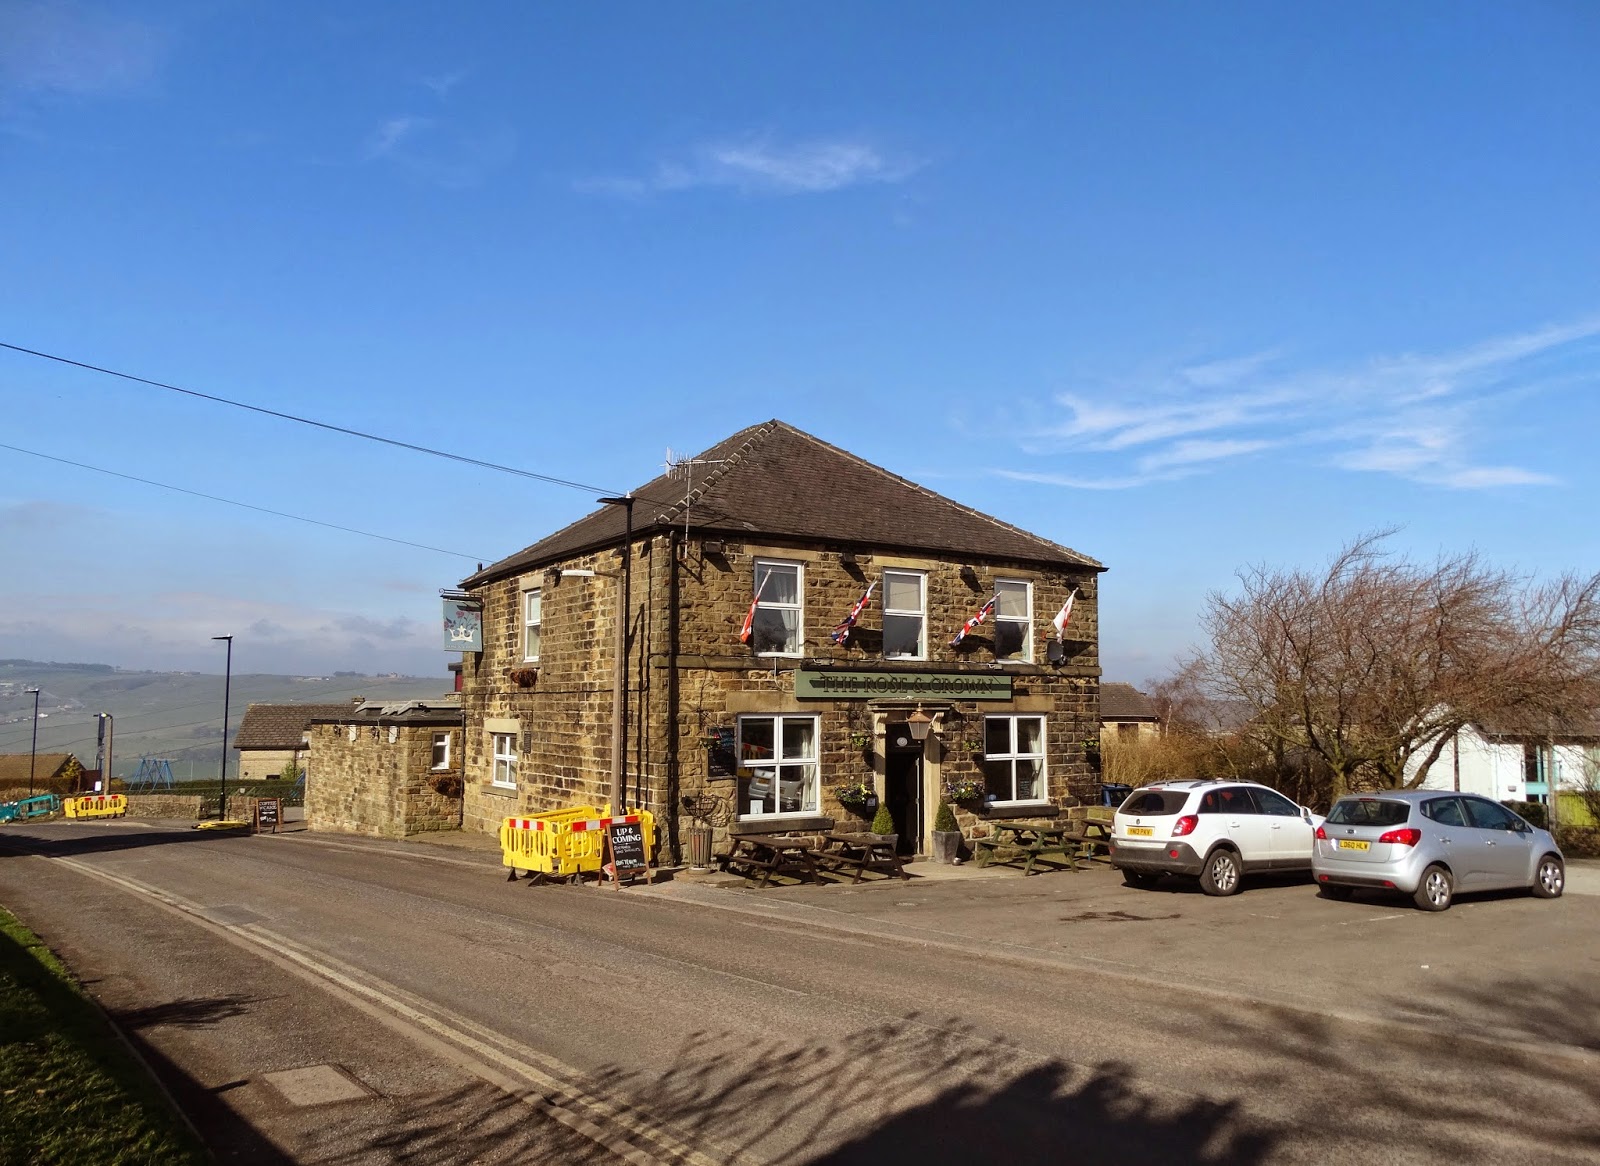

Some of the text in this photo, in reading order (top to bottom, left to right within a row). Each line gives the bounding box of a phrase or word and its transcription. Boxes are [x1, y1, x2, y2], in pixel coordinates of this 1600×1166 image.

[820, 676, 994, 695] THE ROSE & CROWN
[616, 828, 628, 836] UP
[612, 833, 642, 844] COMING
